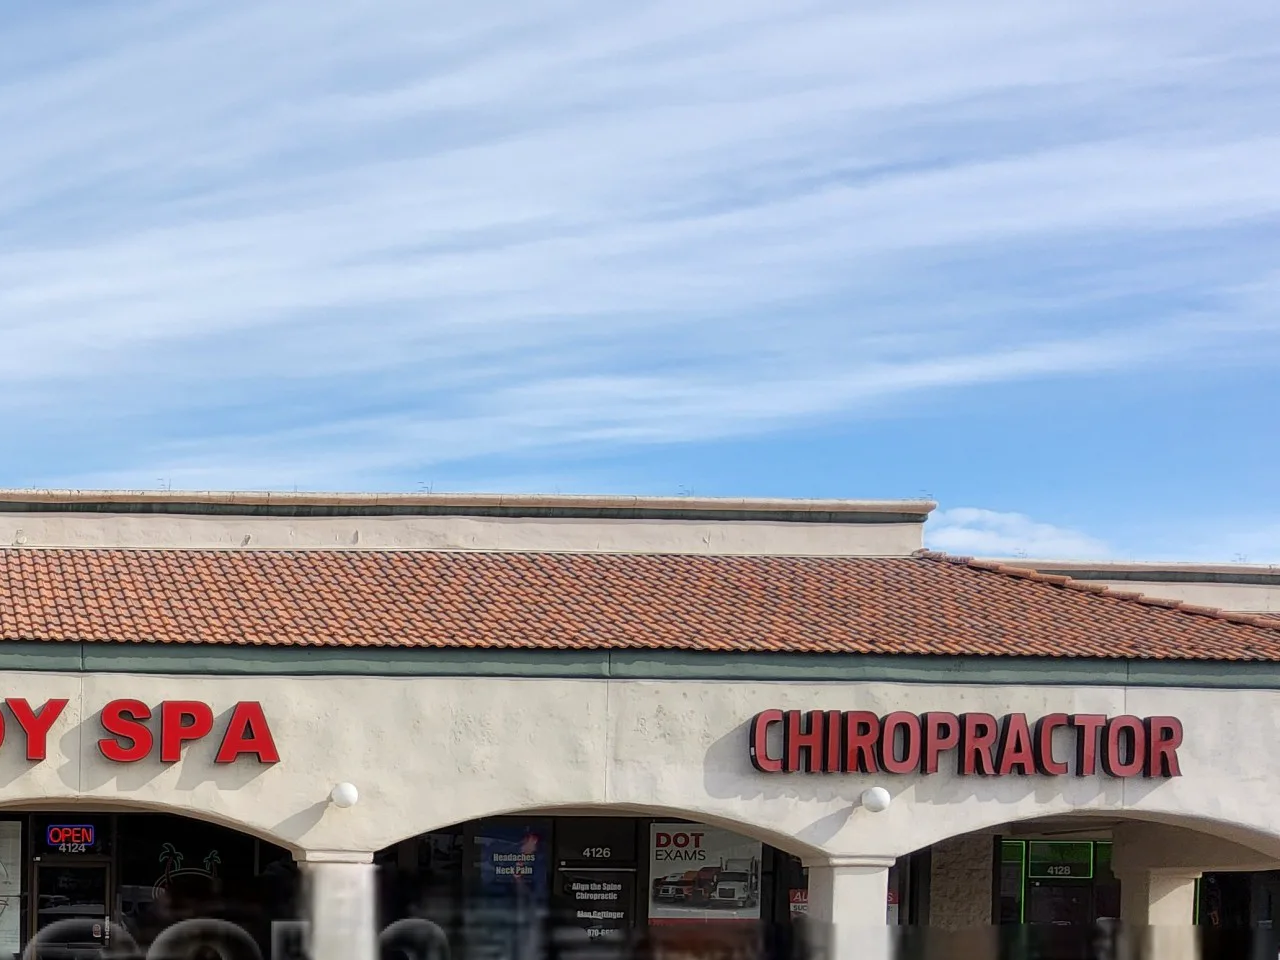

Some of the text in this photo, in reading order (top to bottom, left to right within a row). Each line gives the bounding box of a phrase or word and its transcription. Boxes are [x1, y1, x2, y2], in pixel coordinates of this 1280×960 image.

[98, 698, 280, 764] SPA
[750, 708, 1184, 777] CHIROPRACTOR
[49, 827, 92, 843] OPEN
[655, 832, 705, 848] DOT
[58, 842, 86, 853] 4124
[582, 847, 612, 858] 4126
[493, 853, 535, 862] Headaches
[655, 849, 707, 861] EXAMS
[495, 866, 533, 875] Neck Pain
[1047, 865, 1071, 875] 4128
[590, 883, 601, 891] the
[575, 892, 618, 901] Chiropractic
